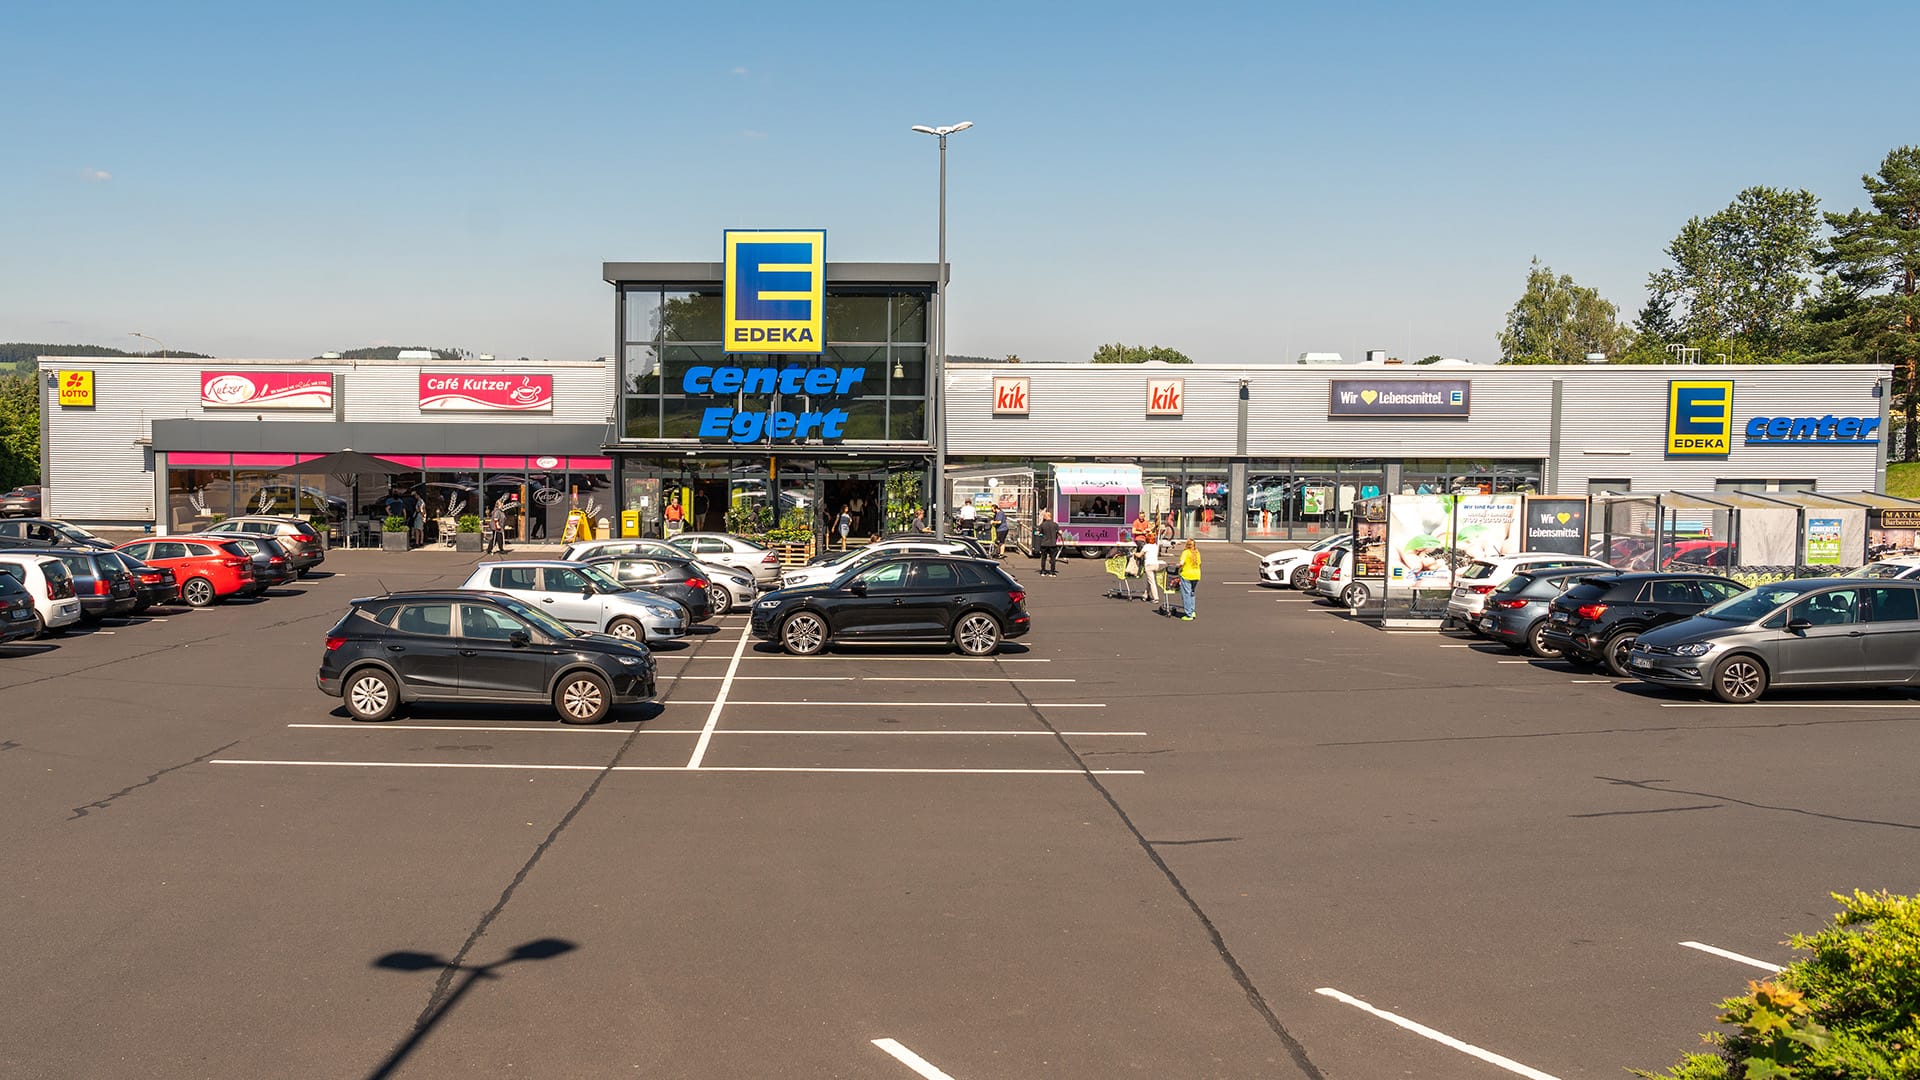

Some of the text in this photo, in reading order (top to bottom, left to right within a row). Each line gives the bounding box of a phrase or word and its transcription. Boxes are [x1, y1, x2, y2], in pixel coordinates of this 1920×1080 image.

[735, 243, 812, 321] E
[734, 328, 814, 342] EDEKA
[207, 378, 244, 402] Kutzer
[427, 378, 511, 390] Café Kutzer
[682, 363, 866, 395] center
[61, 390, 89, 398] LOTTO
[997, 382, 1026, 409] kik
[1151, 383, 1180, 410] kik
[1340, 391, 1444, 405] Wir Lebensmittel.
[1675, 388, 1726, 435] E
[698, 407, 849, 444] Egert
[1746, 414, 1882, 437] center
[1674, 438, 1725, 448] EDEKA
[1540, 513, 1555, 524] Wir
[1529, 528, 1580, 537] Lebensmittel.
